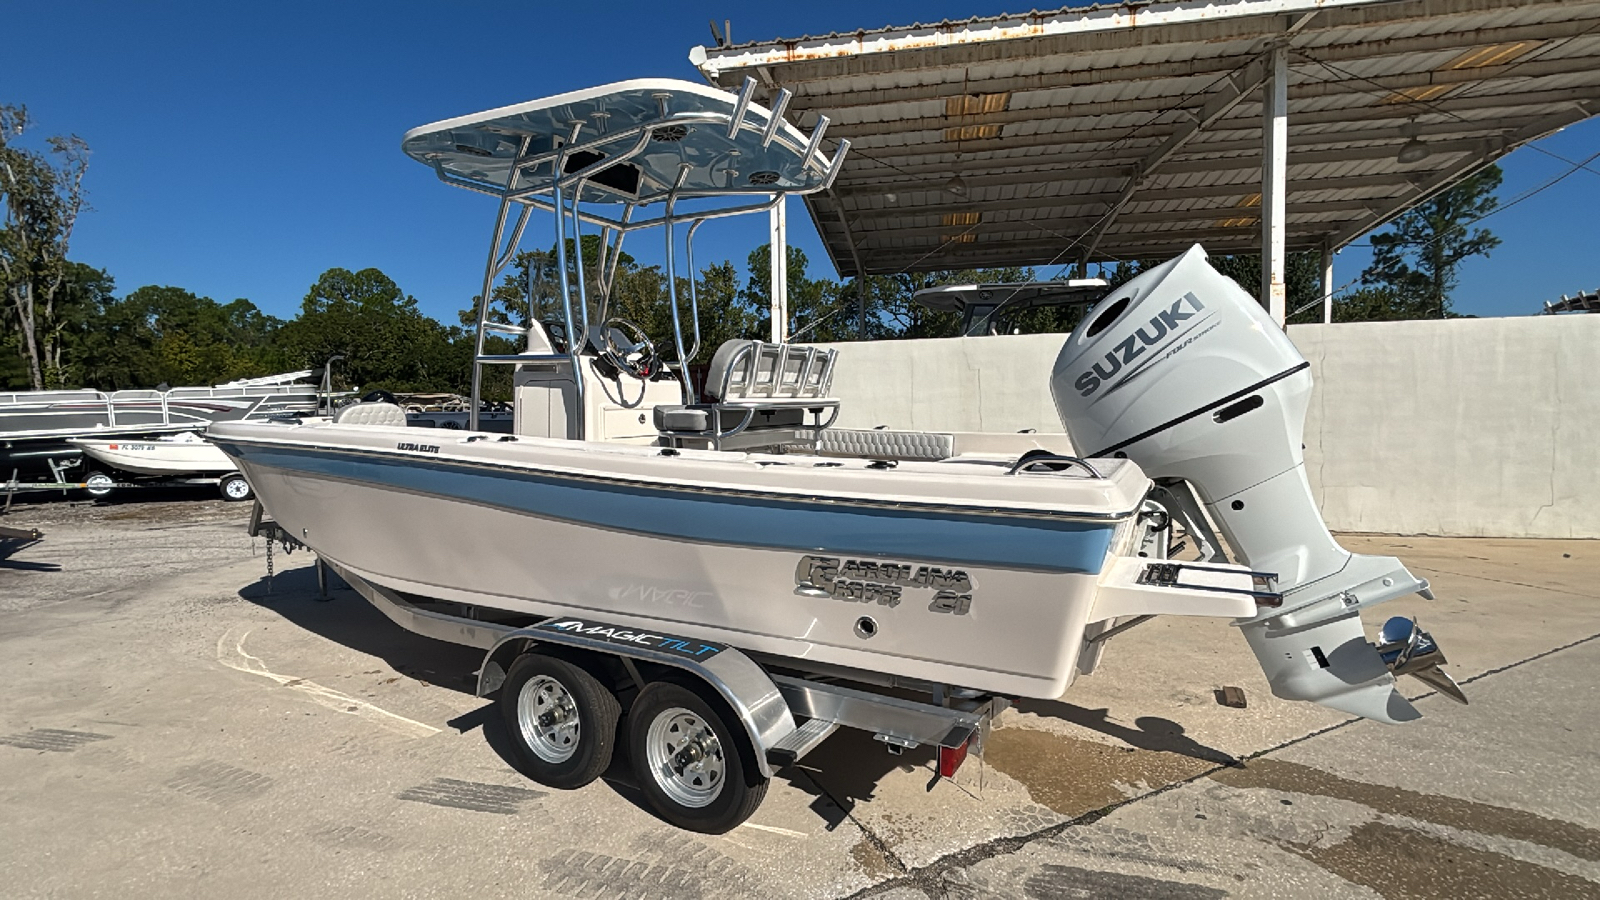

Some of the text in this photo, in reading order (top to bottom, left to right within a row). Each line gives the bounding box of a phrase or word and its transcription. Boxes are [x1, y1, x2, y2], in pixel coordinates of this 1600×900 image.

[1074, 291, 1206, 397] SUZUKI
[1165, 337, 1193, 359] FOUR
[397, 442, 441, 454] ULTRA ELITE
[795, 555, 972, 594] CAROLINA
